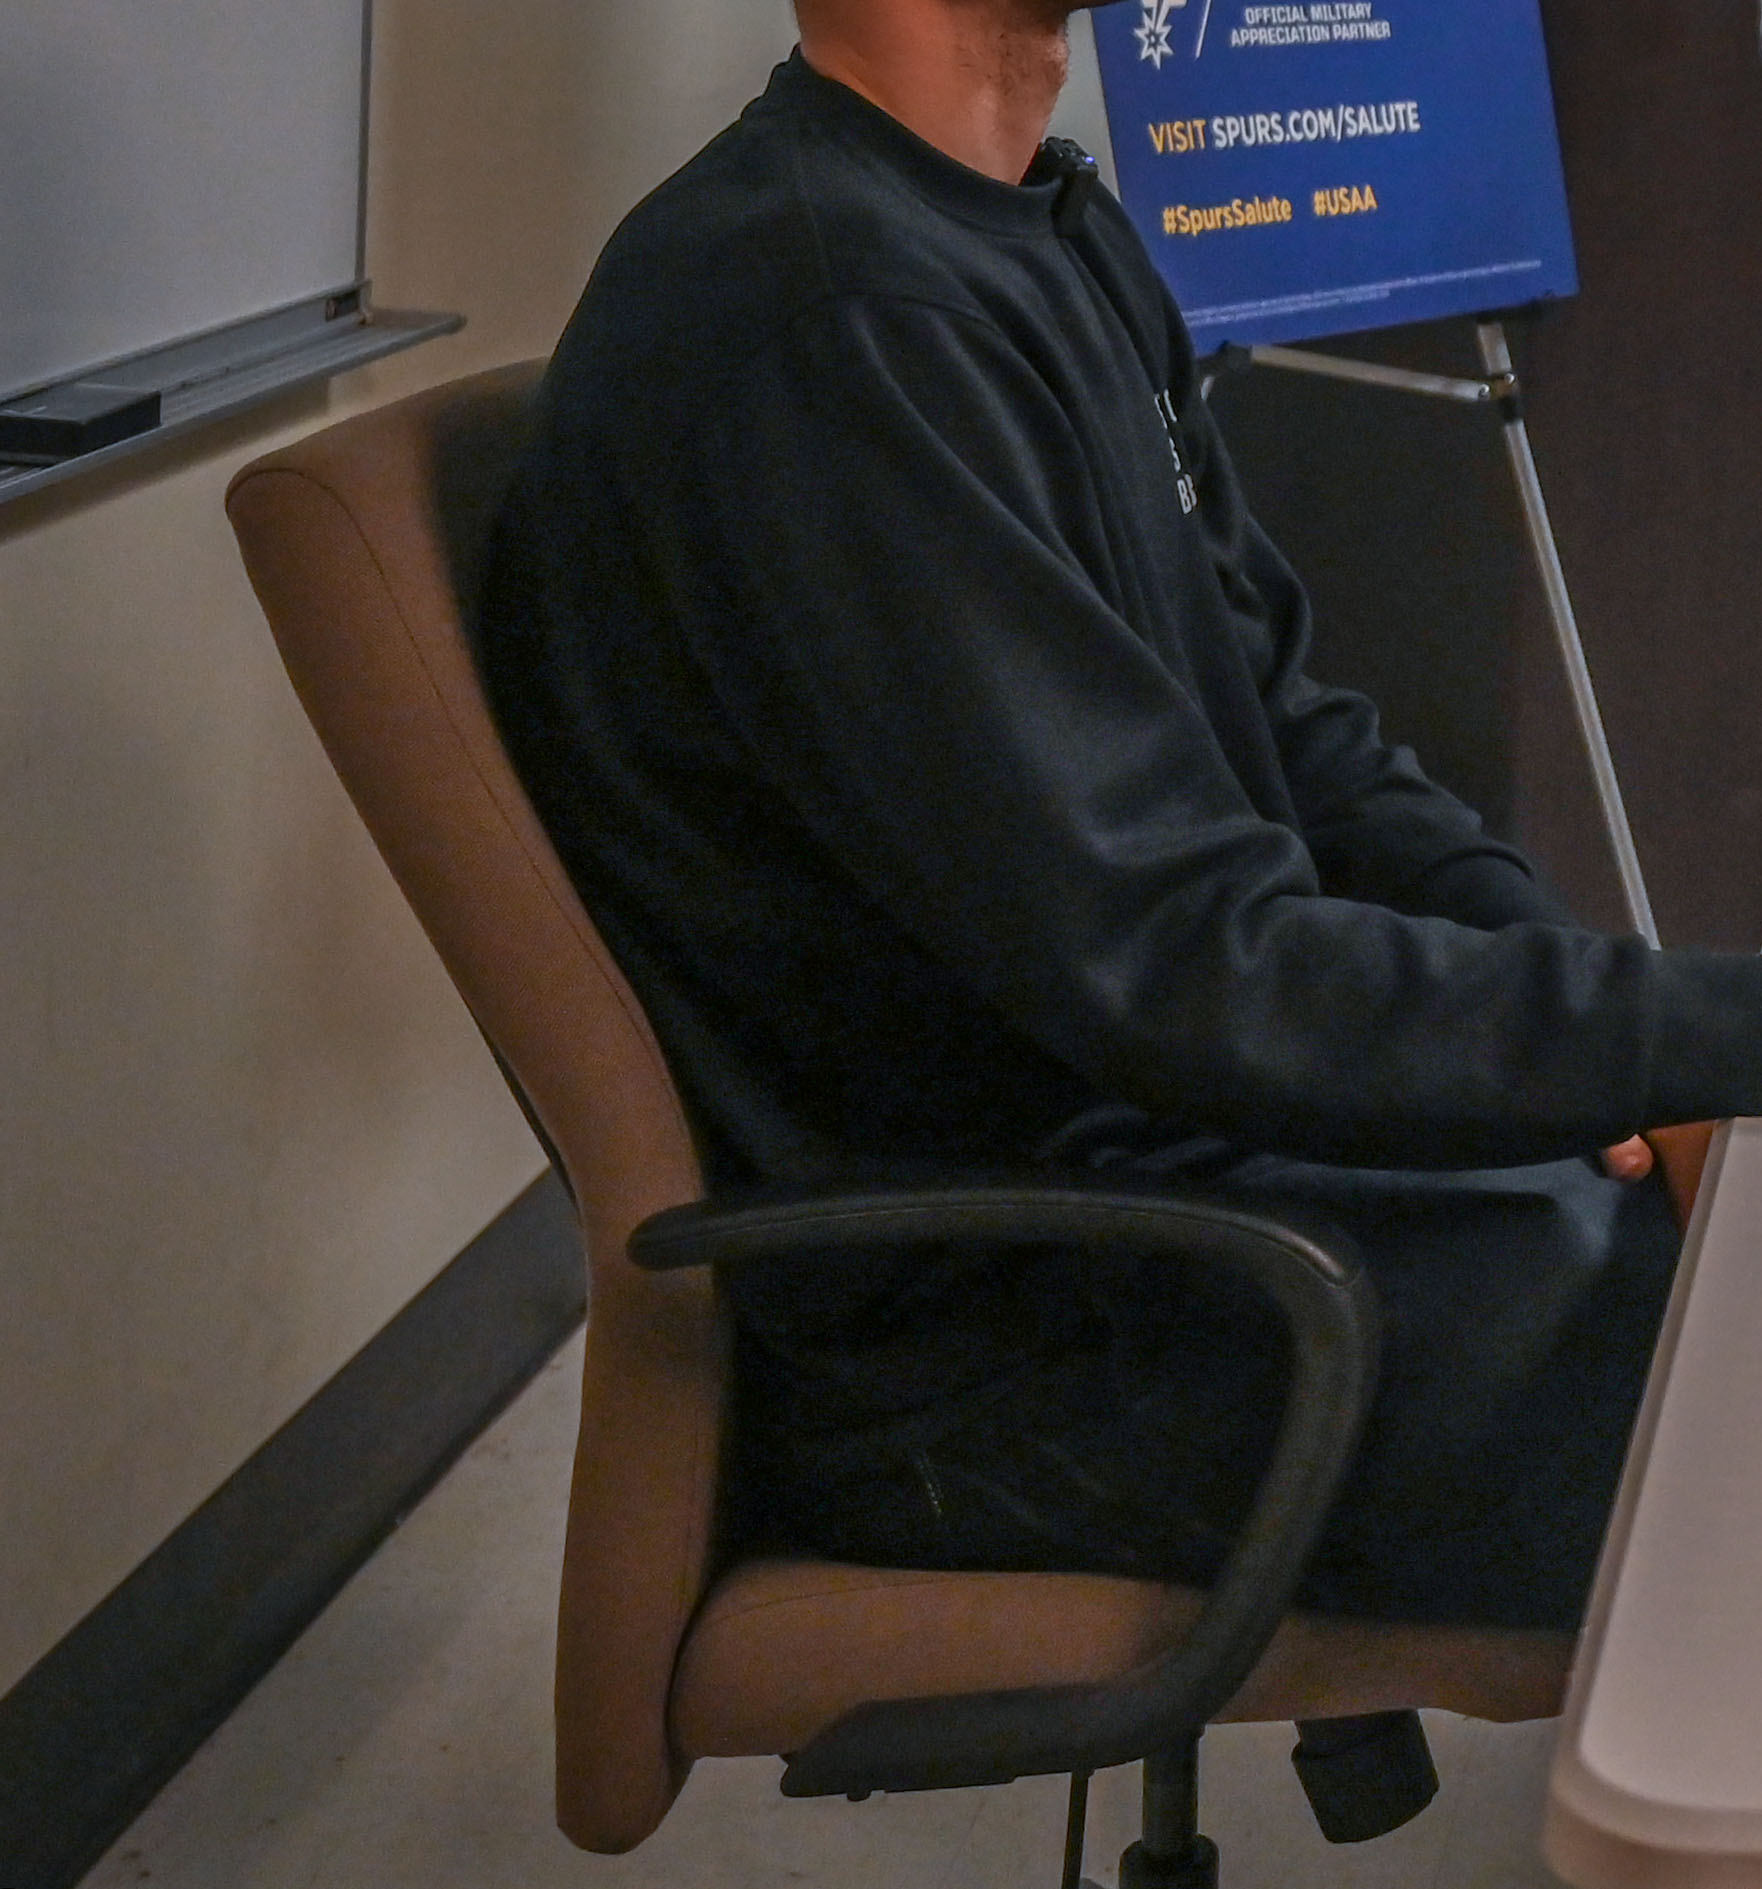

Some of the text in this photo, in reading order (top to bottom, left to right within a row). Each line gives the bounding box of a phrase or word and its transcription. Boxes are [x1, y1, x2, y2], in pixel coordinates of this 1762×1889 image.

[1245, 1, 1372, 25] OFFICIAL MILITARY
[1231, 20, 1391, 47] APPRECIATION PARTNER
[1149, 101, 1421, 154] VISIT SPURS.COM/SALUTE
[1163, 184, 1378, 237] #SpursSalute #USAA
